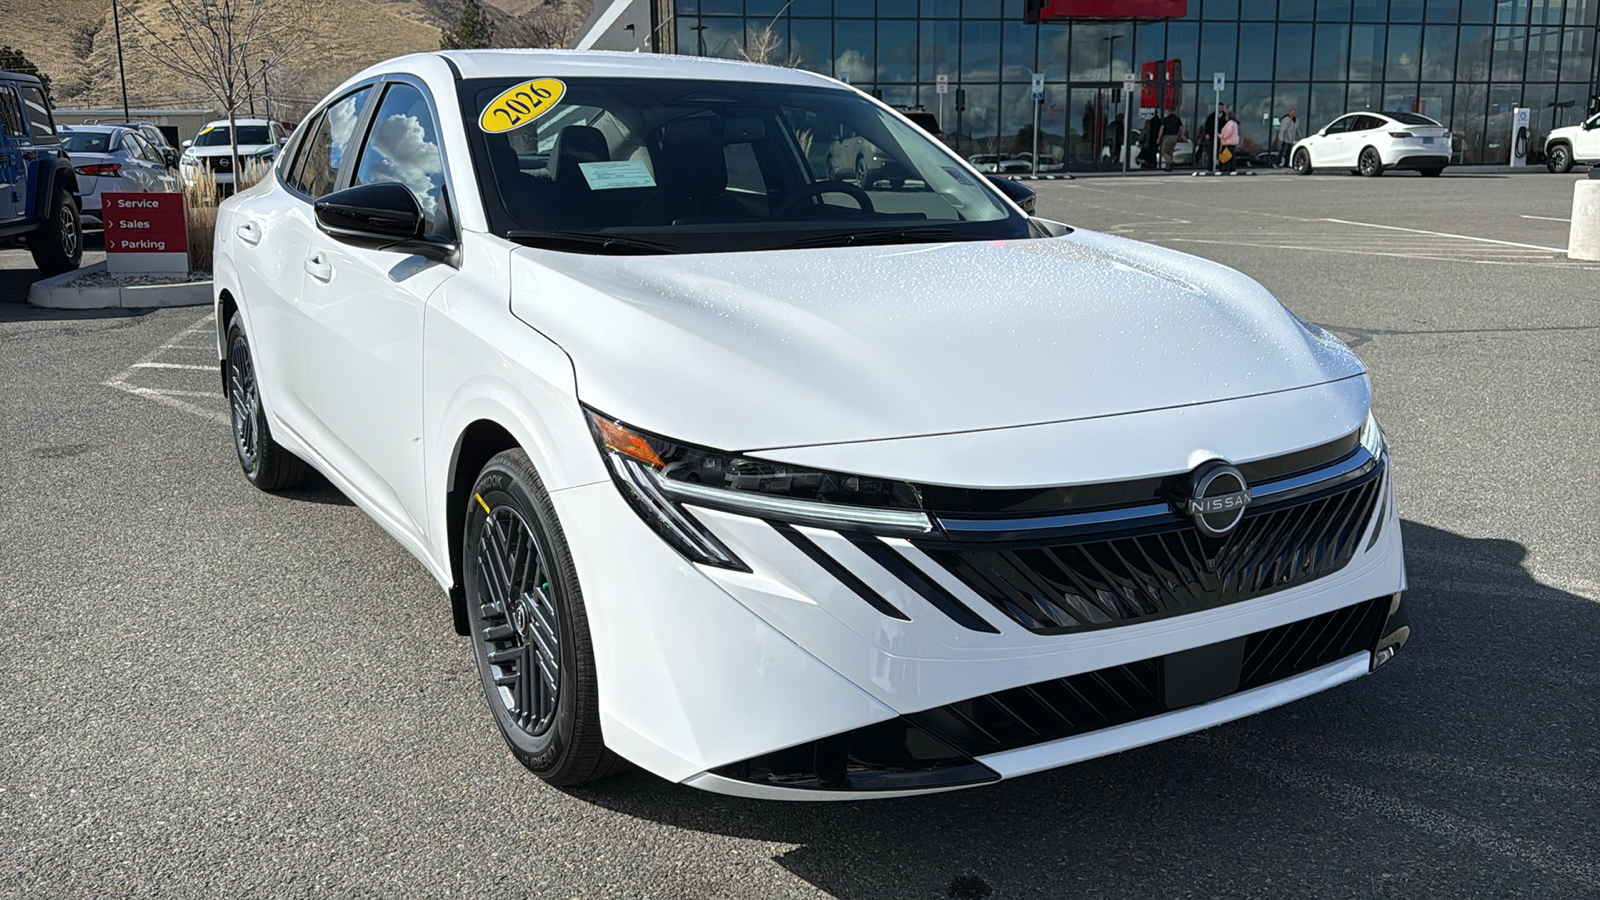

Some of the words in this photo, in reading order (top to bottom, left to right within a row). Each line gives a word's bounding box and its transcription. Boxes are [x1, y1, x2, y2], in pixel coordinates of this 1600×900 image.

[493, 83, 552, 126] 2026
[117, 199, 160, 208] Service
[119, 219, 151, 229] Sales
[121, 239, 166, 251] Parking
[1192, 492, 1251, 512] NISSAN
